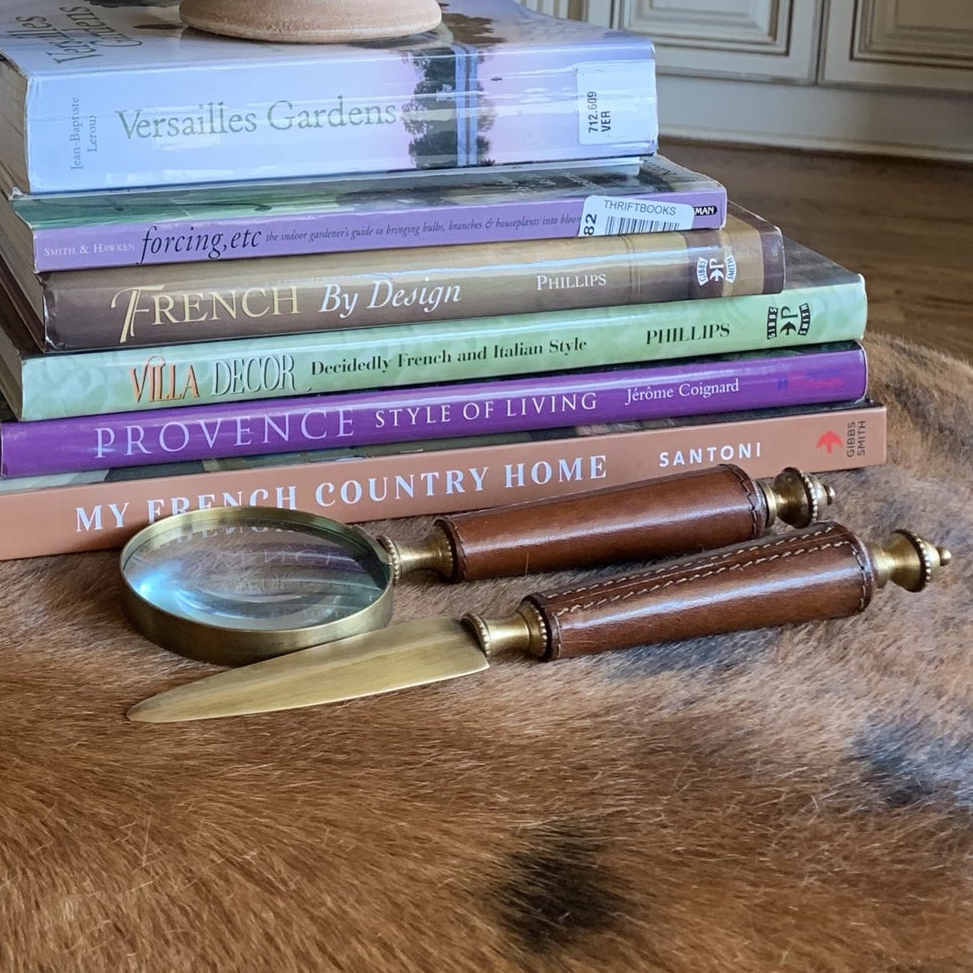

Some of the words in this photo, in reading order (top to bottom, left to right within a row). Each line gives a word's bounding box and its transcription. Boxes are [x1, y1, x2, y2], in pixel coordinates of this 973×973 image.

[114, 101, 258, 140] Versailles
[266, 94, 397, 131] Gardens
[587, 91, 599, 134] 712.609
[600, 110, 612, 133] VER
[69, 97, 84, 171] Jean-Baptiste
[583, 213, 598, 236] 82
[603, 199, 677, 216] THRIFTBOOKS
[265, 230, 279, 243] the
[281, 229, 308, 243] indoor
[309, 227, 350, 243] gardener's
[351, 225, 373, 240] guide
[375, 226, 385, 236] to
[385, 223, 420, 238] bringing
[448, 217, 483, 230] branches
[484, 216, 493, 229] &
[495, 214, 541, 231] houseplants
[542, 216, 559, 227] into
[79, 245, 89, 255] &
[726, 255, 736, 282] SMITH
[697, 258, 708, 284] GIBBS
[110, 284, 300, 344] FRENCH
[318, 282, 359, 319] By
[367, 276, 462, 313] Design
[536, 273, 608, 291] PHILLIPS
[768, 307, 778, 339] GIBBS
[129, 355, 200, 404] VILLA
[211, 353, 297, 398] DECOR
[311, 355, 391, 376] Decidedly
[398, 349, 452, 368] French
[457, 346, 488, 361] and
[493, 342, 544, 359] Italian
[549, 337, 587, 356] Style
[645, 322, 731, 346] PHILLIPS
[94, 408, 355, 459] PROVENCE
[375, 404, 452, 428] STYLE
[462, 401, 495, 421] OF
[506, 392, 598, 417] LIVING
[624, 384, 674, 406] Jérôme
[678, 378, 740, 400] Coignard
[846, 421, 856, 458] GIBBS
[857, 420, 867, 457] SMITH
[75, 502, 131, 533] MY
[146, 485, 297, 525] FRENCH
[315, 466, 489, 507] COUNTRY
[504, 454, 607, 489] HOME
[658, 441, 762, 468] SANTONI
